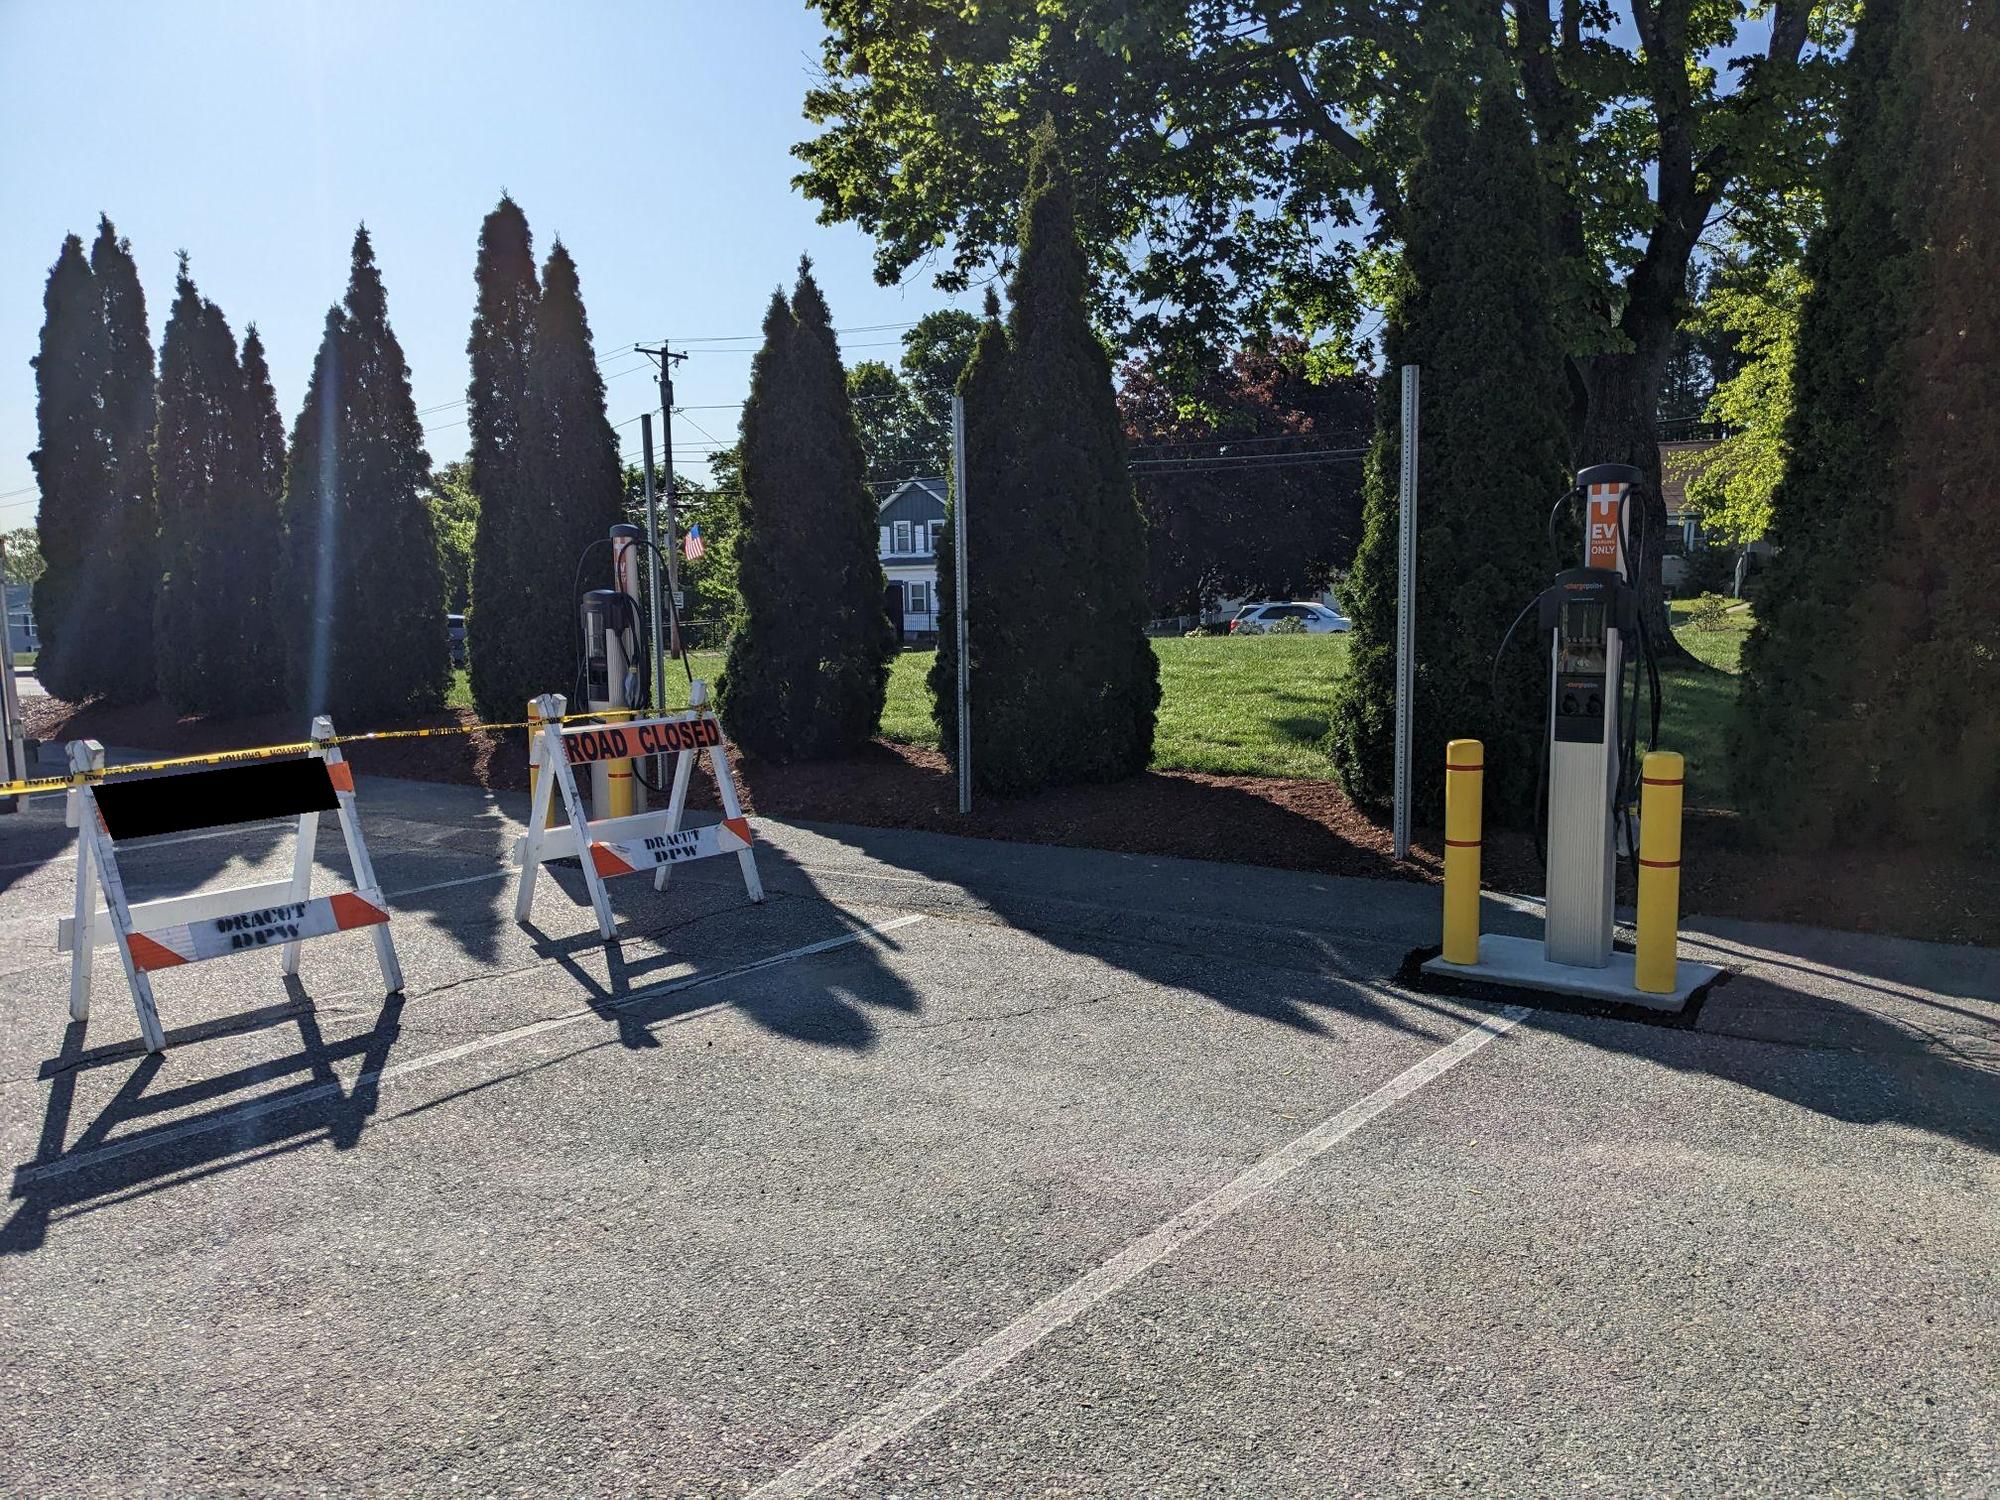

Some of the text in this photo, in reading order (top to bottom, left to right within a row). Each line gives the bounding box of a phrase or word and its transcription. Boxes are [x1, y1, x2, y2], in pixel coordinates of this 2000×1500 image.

[1591, 523, 1617, 539] EV
[1591, 545, 1616, 555] ONLY
[564, 719, 720, 763] ROAD CLOSED
[644, 829, 700, 850] DRACUT
[654, 845, 697, 863] DPW
[217, 903, 306, 933] DRACUT
[231, 923, 299, 950] DPW
